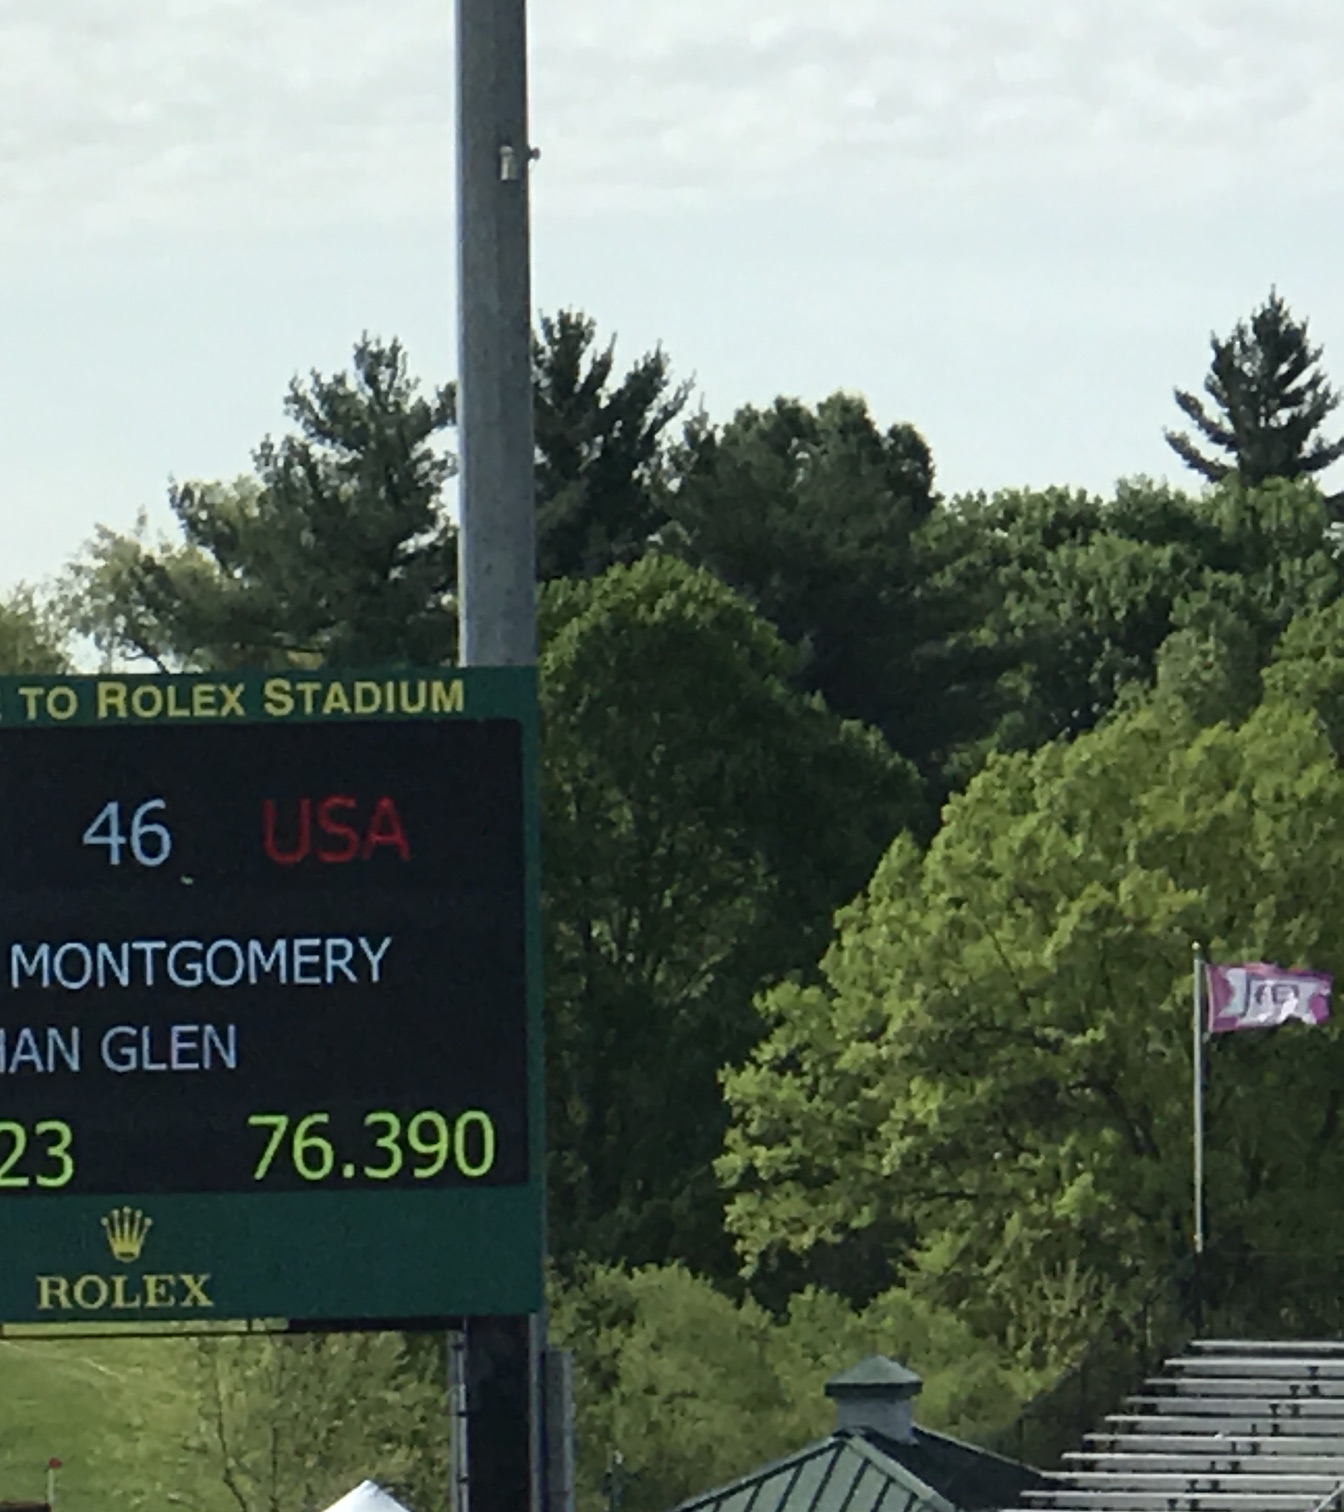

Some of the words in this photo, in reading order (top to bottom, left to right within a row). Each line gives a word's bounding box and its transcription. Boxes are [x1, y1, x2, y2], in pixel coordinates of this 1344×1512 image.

[18, 686, 78, 720] TO
[98, 680, 245, 718] ROLEX
[263, 678, 464, 716] STADIUM
[83, 797, 172, 867] 46
[265, 797, 410, 863] USA
[11, 935, 392, 990] MONTGOMERY
[101, 1022, 238, 1074] GLEN
[247, 1110, 496, 1181] 76.390
[36, 1273, 214, 1310] ROLEX
